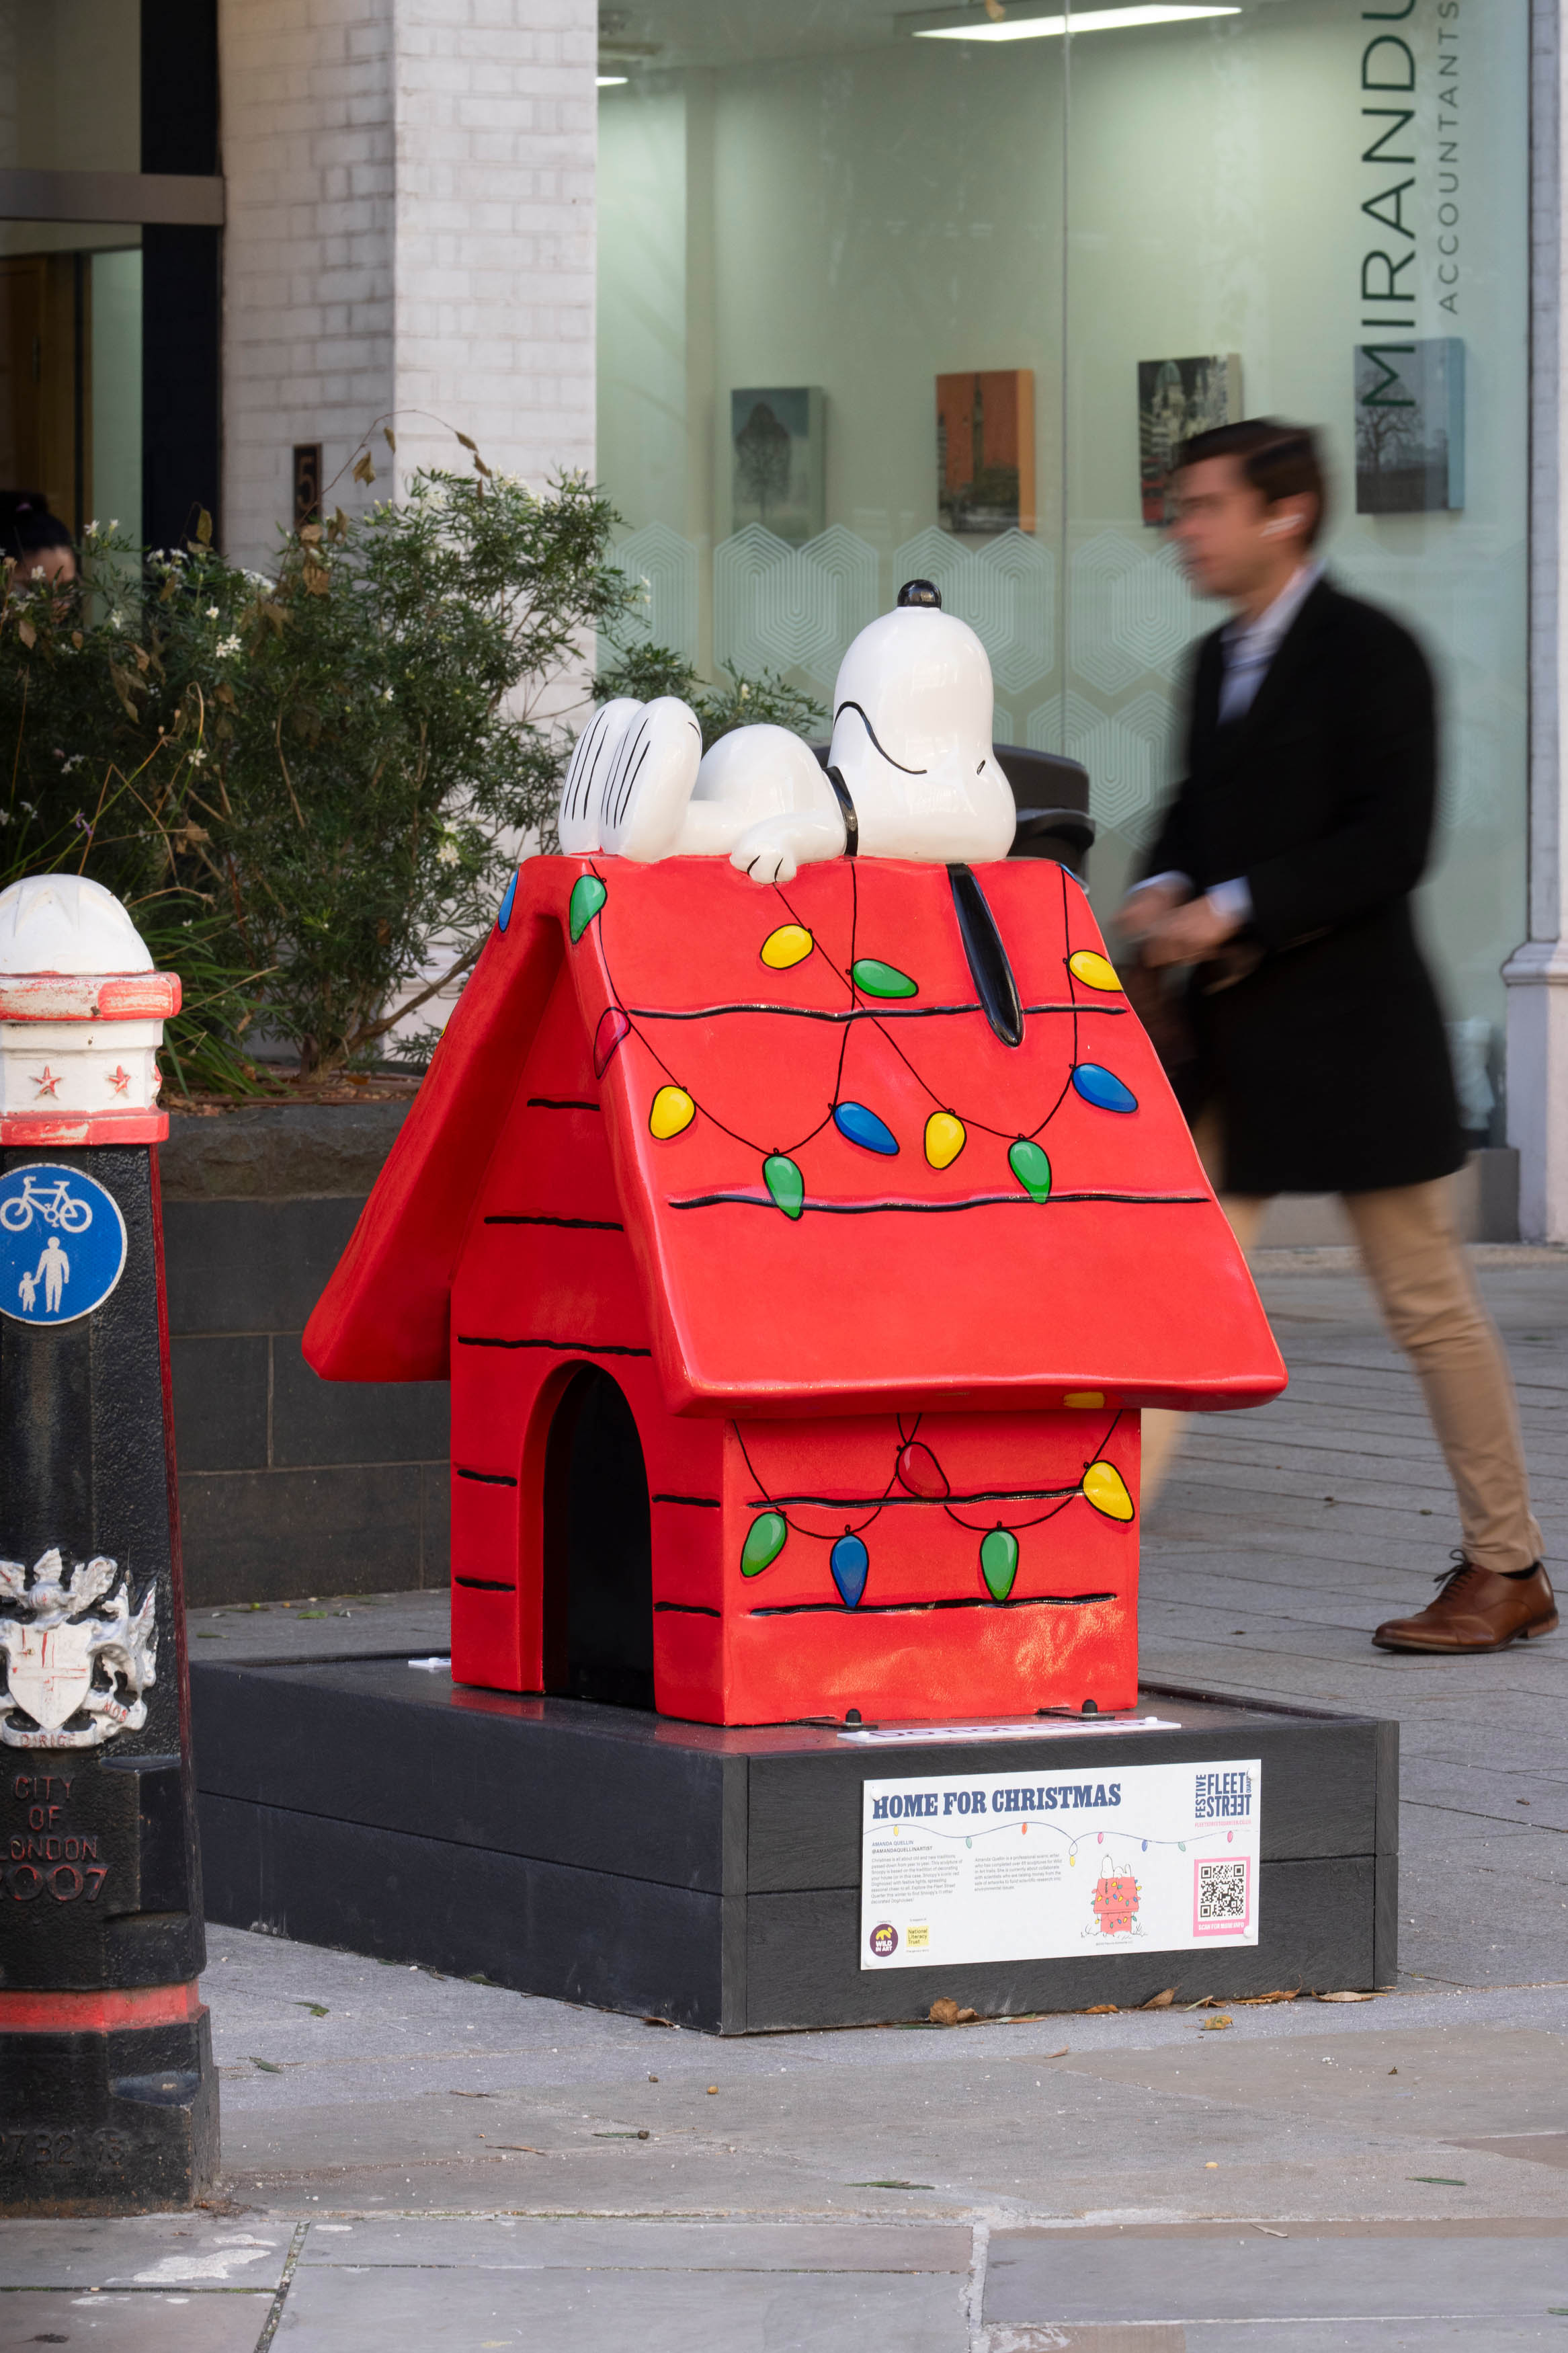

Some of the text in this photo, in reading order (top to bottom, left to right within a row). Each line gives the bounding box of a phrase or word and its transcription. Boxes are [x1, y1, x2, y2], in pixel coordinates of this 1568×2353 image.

[1438, 1, 1460, 315] ACCOUNTANTS
[947, 1725, 1018, 1733] not
[1029, 1720, 1146, 1730] climb
[15, 1775, 76, 1800] CITY
[1195, 1774, 1206, 1818] FESTIVE
[1207, 1772, 1245, 1795] FLEET
[873, 1783, 1121, 1819] HOME FOR CHRISTMAS
[29, 1805, 63, 1831] OF
[872, 1845, 933, 1854] @AMANDAQUELLINARTIST
